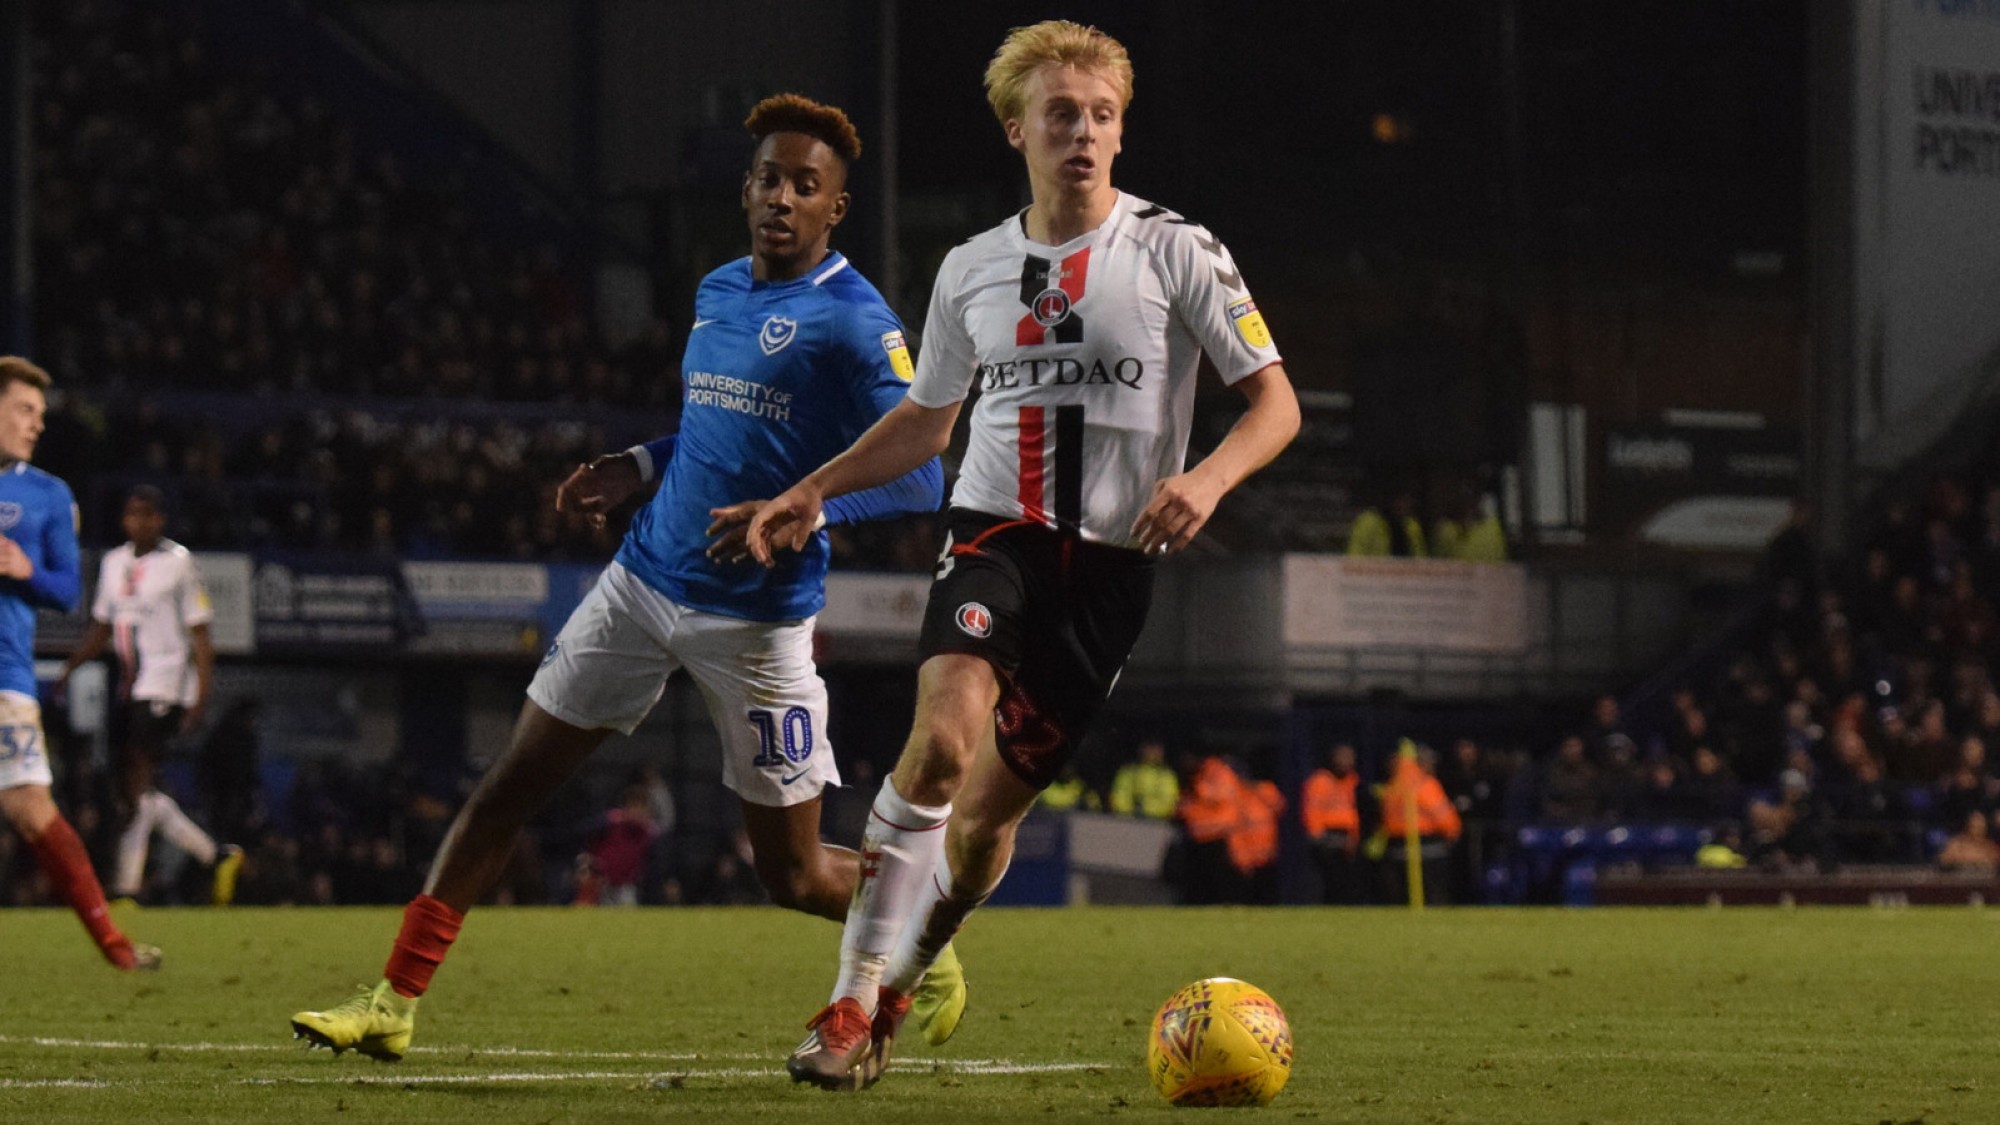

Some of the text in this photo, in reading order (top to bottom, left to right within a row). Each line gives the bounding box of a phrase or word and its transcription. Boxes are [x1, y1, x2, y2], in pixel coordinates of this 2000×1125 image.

[688, 371, 794, 405] UNIVERSITY OF
[688, 388, 791, 421] PORTSMOUTH
[0, 724, 40, 760] 32
[748, 705, 813, 768] 10
